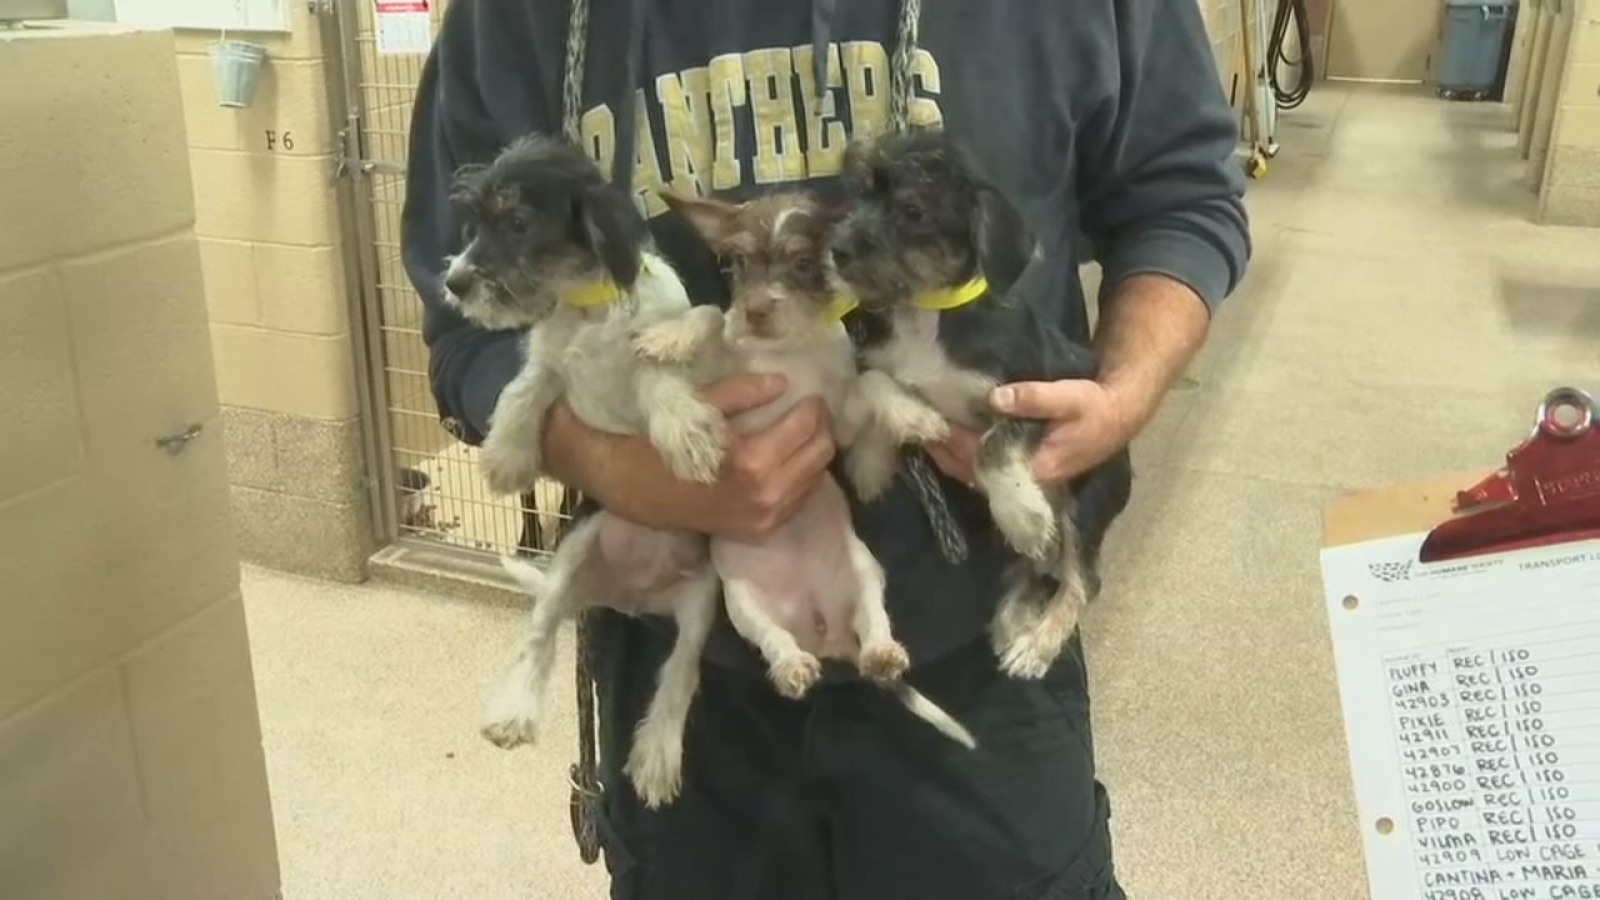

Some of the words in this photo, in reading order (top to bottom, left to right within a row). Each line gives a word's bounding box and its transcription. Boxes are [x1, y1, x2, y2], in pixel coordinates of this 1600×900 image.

[581, 40, 944, 220] PANTHERS
[1519, 553, 1586, 571] TRANSPORT
[1392, 681, 1430, 697] GINA
[1399, 713, 1444, 729] PIXIE
[1417, 817, 1459, 833] PIPO
[1540, 844, 1585, 860] CAGE
[1425, 869, 1503, 887] CANTINA
[1522, 865, 1587, 881] MARIA
[1549, 885, 1600, 899] CAGE
